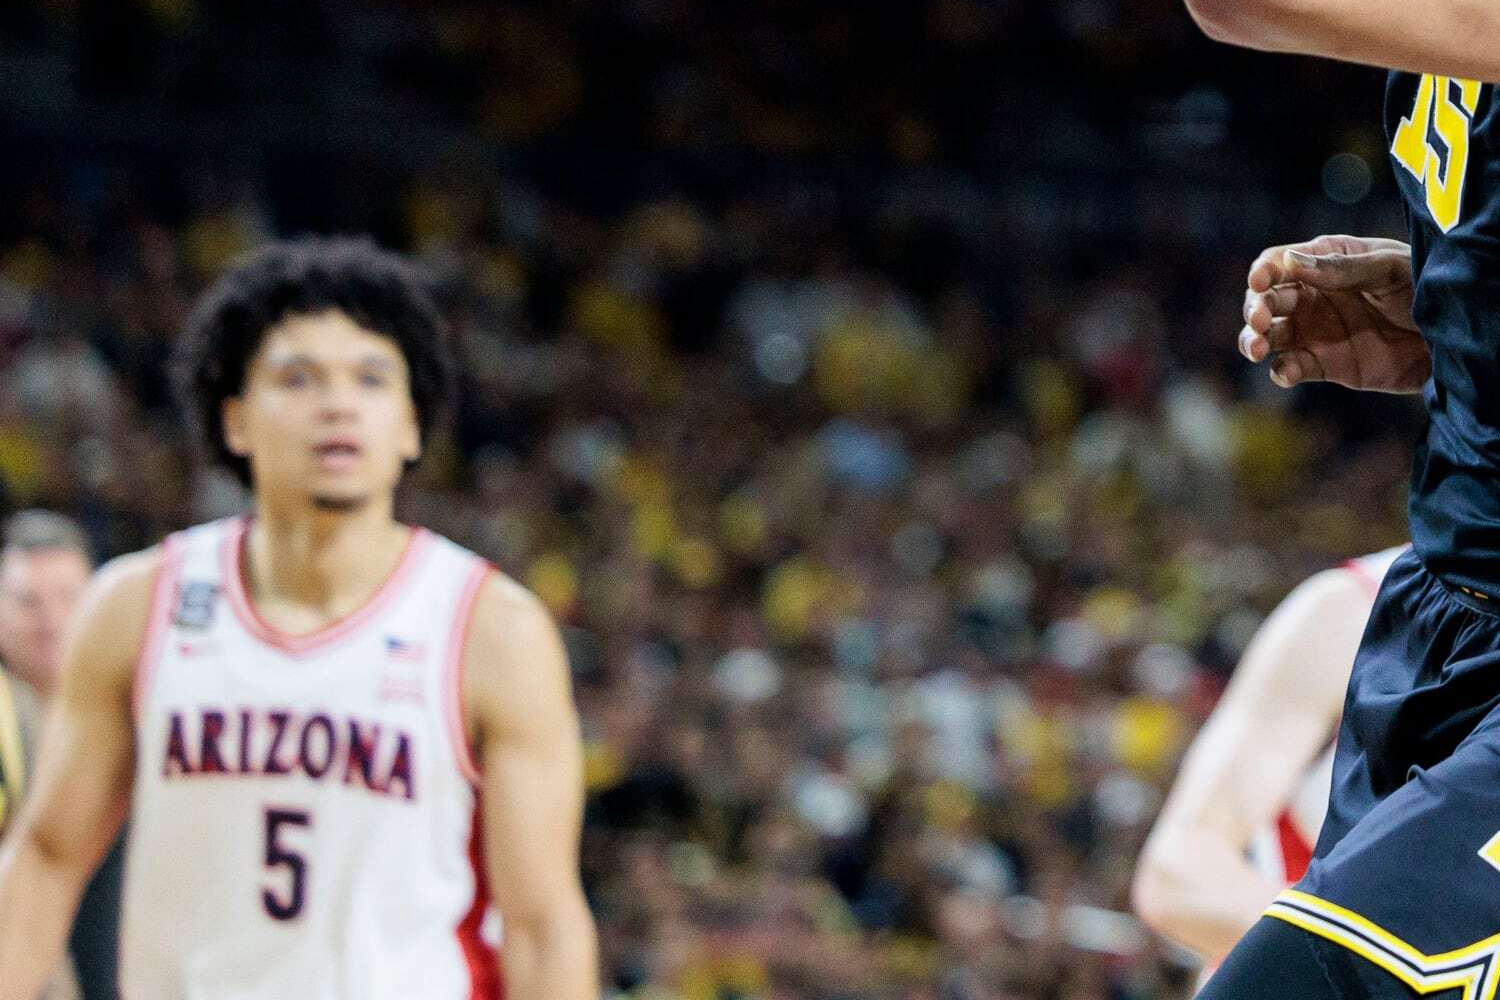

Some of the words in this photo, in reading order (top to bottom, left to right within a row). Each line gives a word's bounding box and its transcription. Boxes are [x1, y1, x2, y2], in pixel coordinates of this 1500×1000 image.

[1390, 73, 1482, 234] 15
[162, 709, 415, 802] ARIZONA
[261, 807, 314, 922] 5
